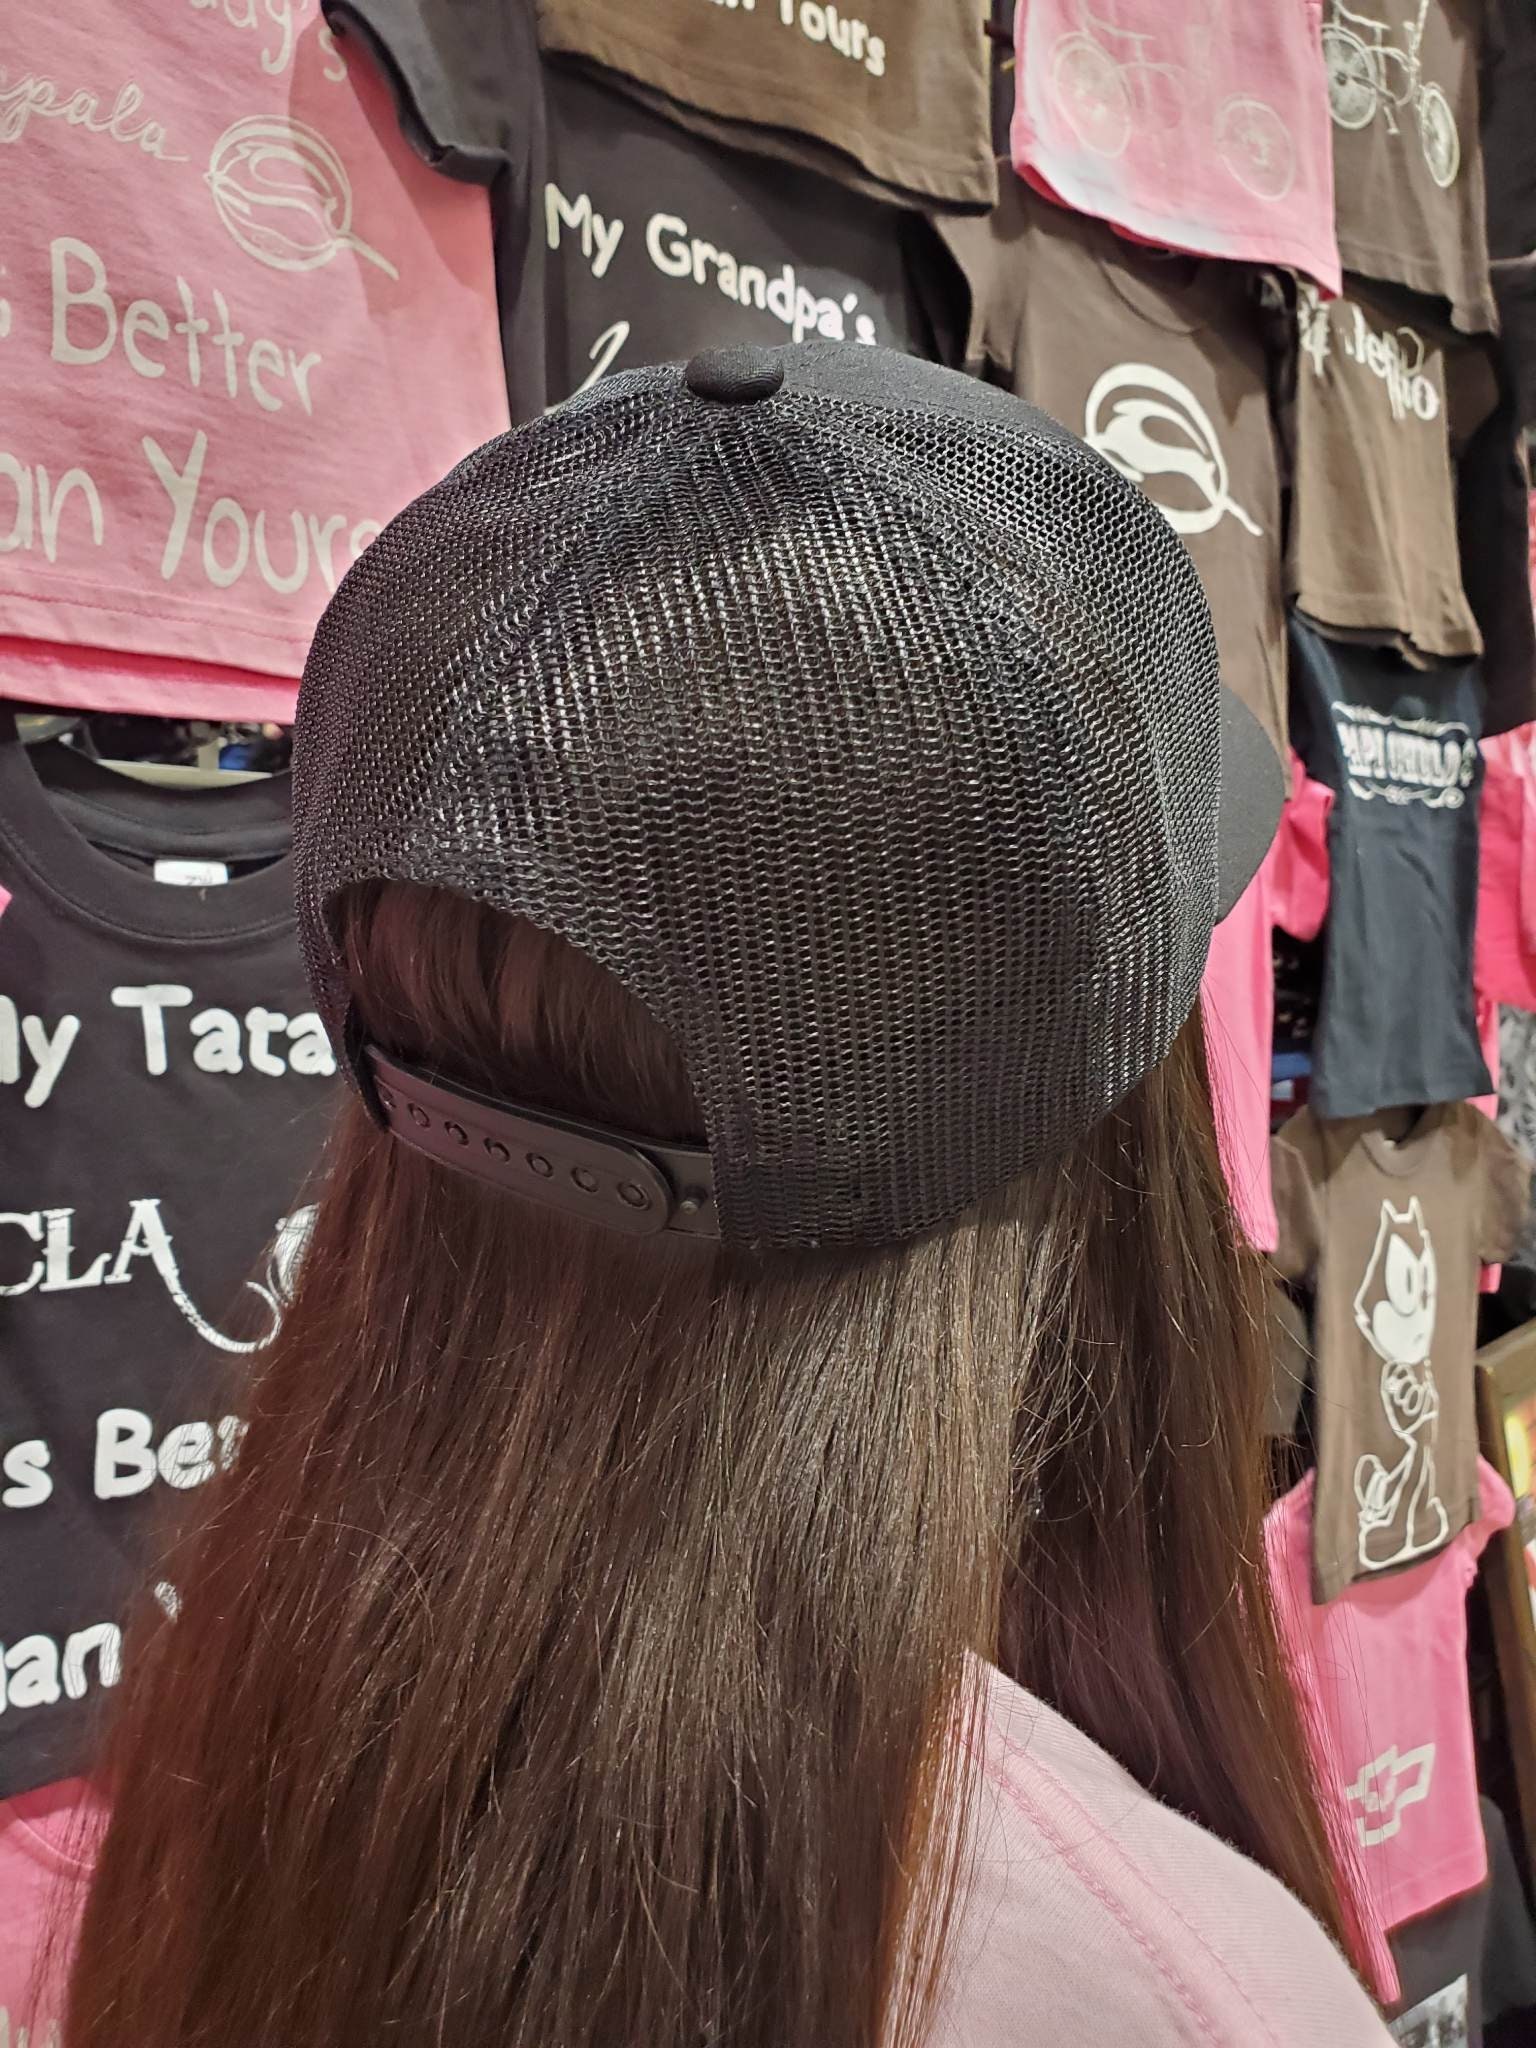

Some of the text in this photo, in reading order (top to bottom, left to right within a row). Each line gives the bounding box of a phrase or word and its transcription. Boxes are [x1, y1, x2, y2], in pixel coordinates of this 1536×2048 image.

[50, 238, 321, 416] Better
[545, 183, 876, 345] My Grandpa's
[110, 984, 336, 1077] Tata
[2, 1440, 53, 1508] s
